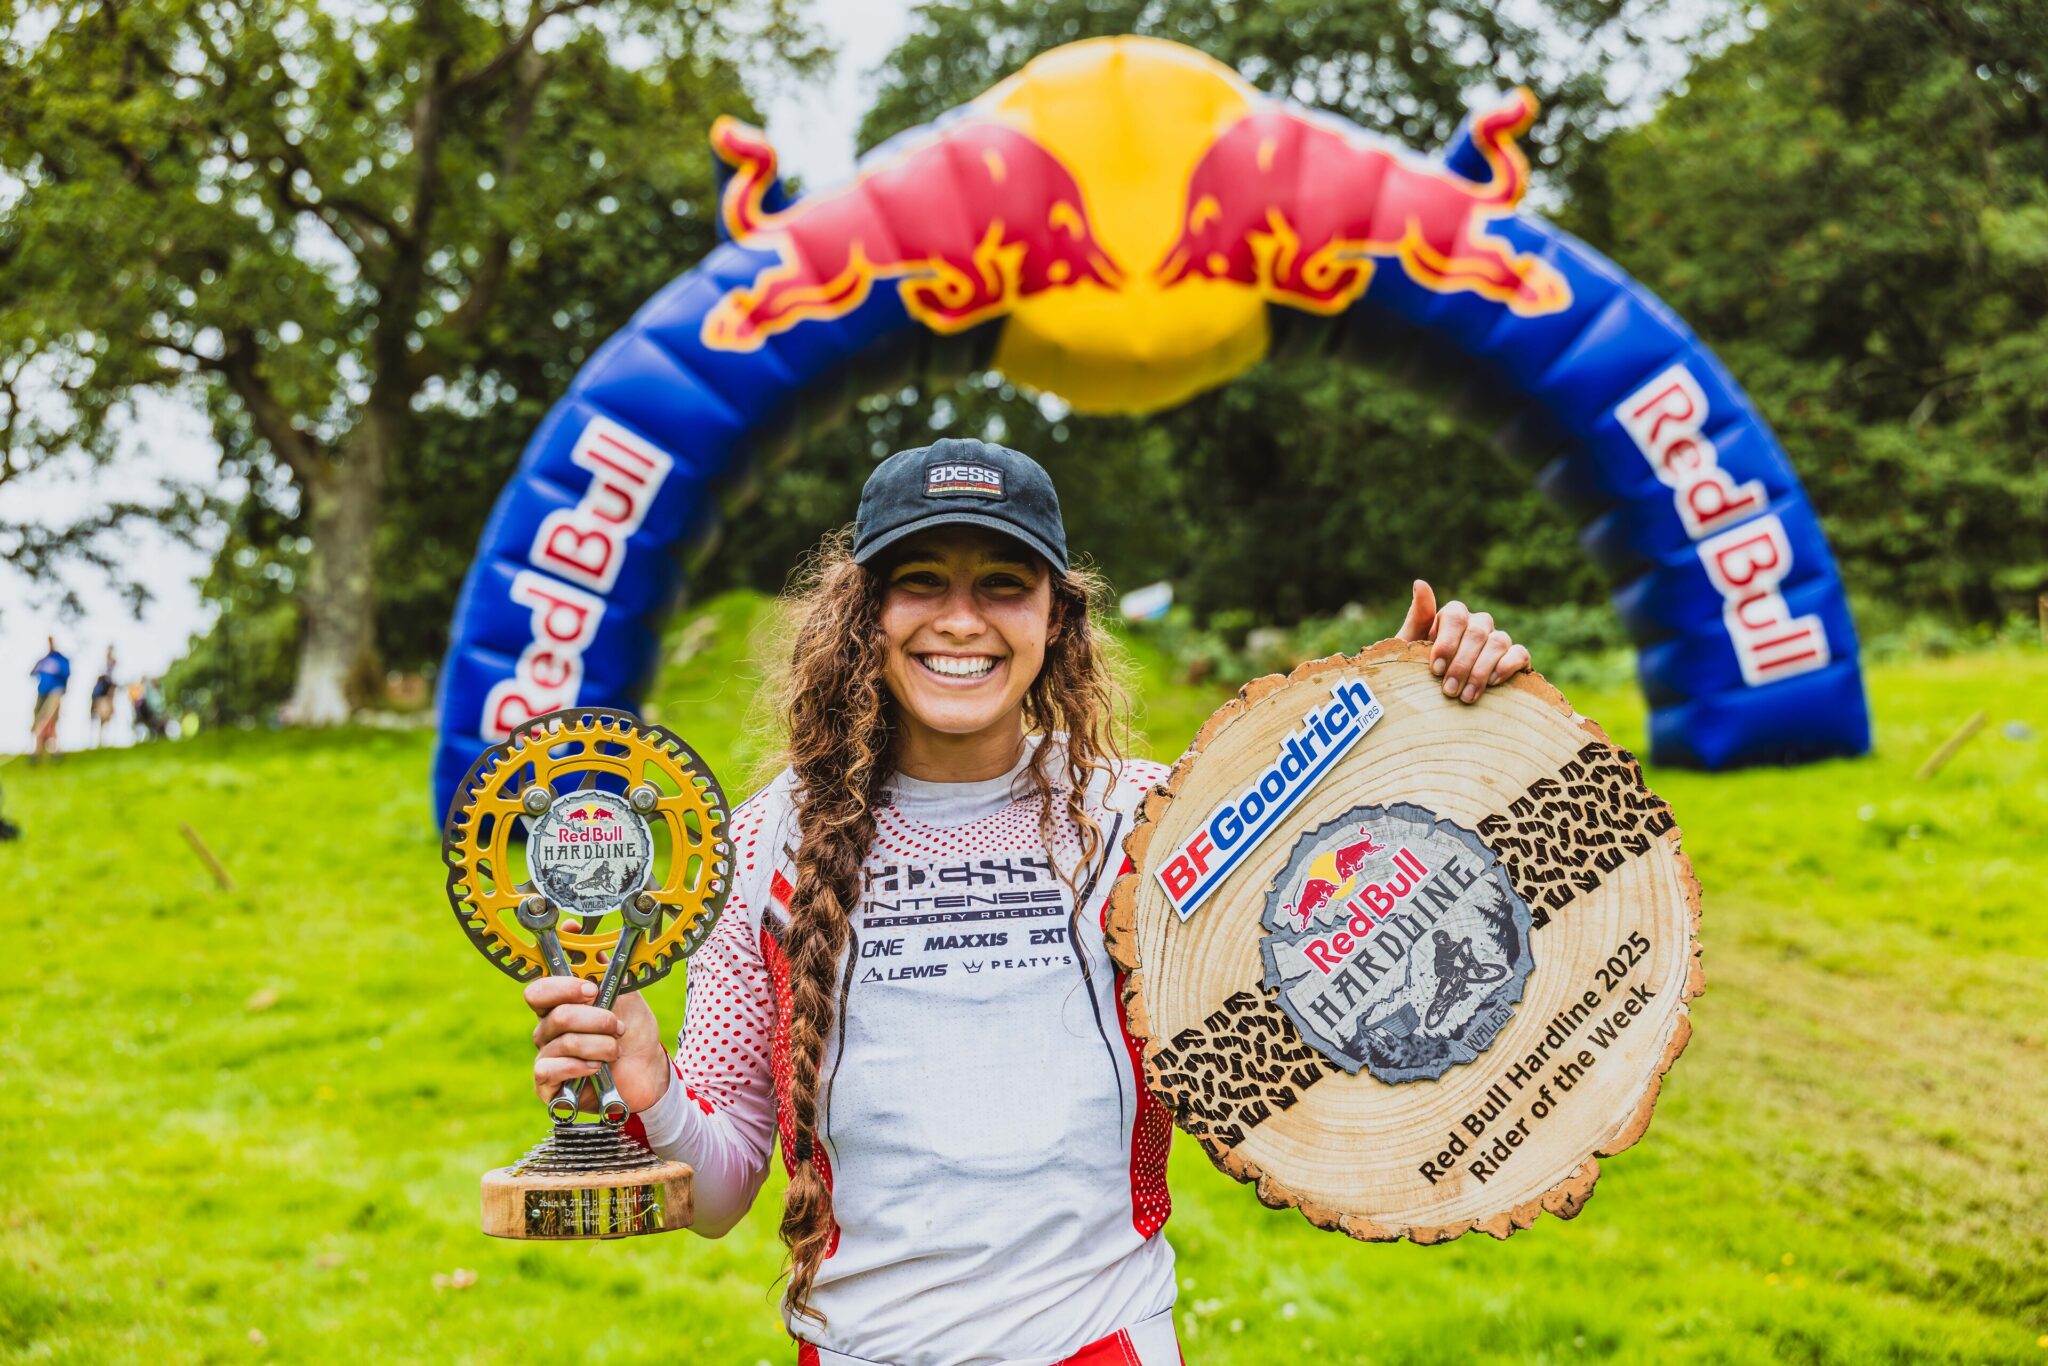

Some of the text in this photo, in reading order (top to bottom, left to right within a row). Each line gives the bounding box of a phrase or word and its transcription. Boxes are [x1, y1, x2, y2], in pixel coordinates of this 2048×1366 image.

[930, 466, 1000, 485] axess
[1633, 383, 1817, 671] Red Bull
[494, 433, 655, 738] Red Bull
[1356, 705, 1380, 729] Tires
[1160, 681, 1372, 902] BFGoodrich
[559, 826, 623, 843] Red Bull
[544, 842, 636, 861] HARDLINE
[581, 900, 606, 910] WALES
[864, 889, 1062, 914] INTENSE
[1303, 847, 1429, 976] Red Bull
[871, 907, 1056, 926] FACTORY RACING
[923, 932, 1009, 951] MAXXIS
[1029, 927, 1067, 945] EXT
[1309, 855, 1478, 1030] HARDLINE
[552, 957, 560, 966] 13
[888, 955, 1072, 981] LEWIS PEATY'S
[1463, 1006, 1511, 1051] WALES
[1418, 931, 1651, 1185] Red Bull Hardline 2025
[1468, 983, 1657, 1184] Rider of the Week
